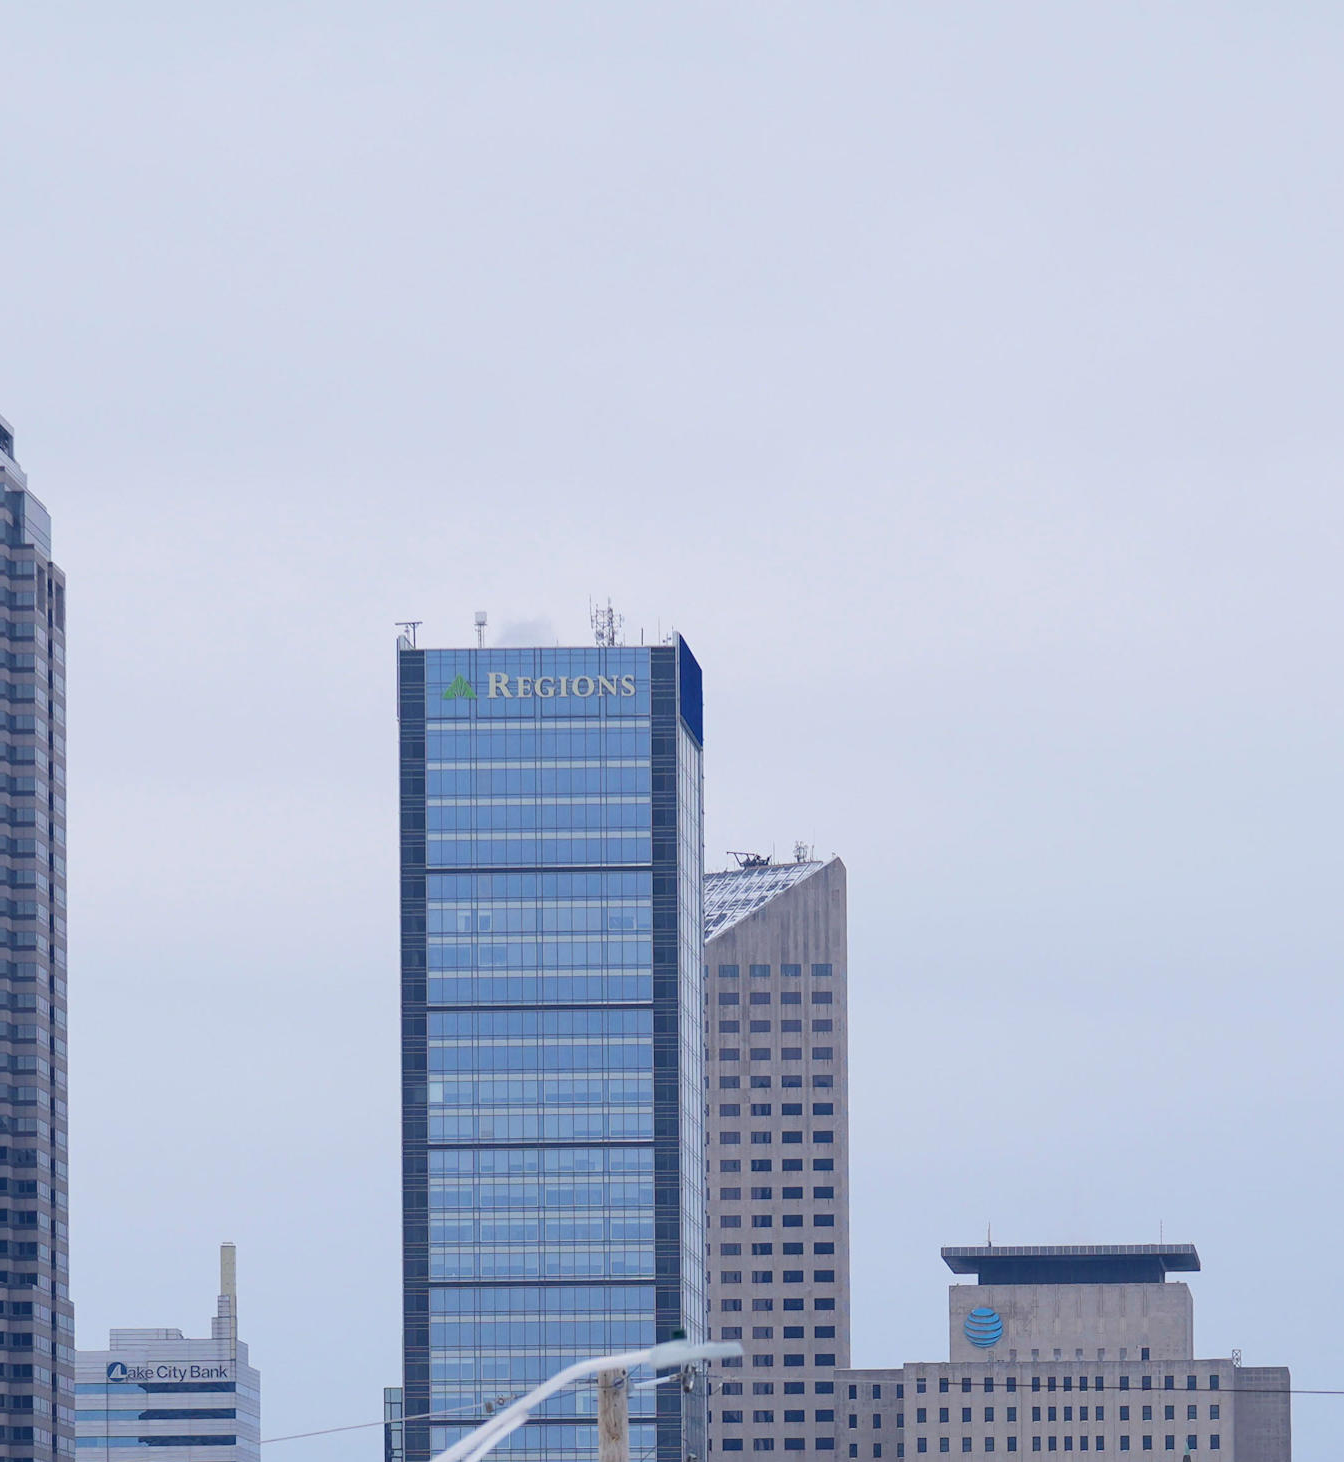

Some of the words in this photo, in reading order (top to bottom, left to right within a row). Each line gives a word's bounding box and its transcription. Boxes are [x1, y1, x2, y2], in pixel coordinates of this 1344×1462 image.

[486, 671, 637, 699] REGIONS
[156, 1365, 187, 1382] City
[190, 1364, 228, 1379] Bank
